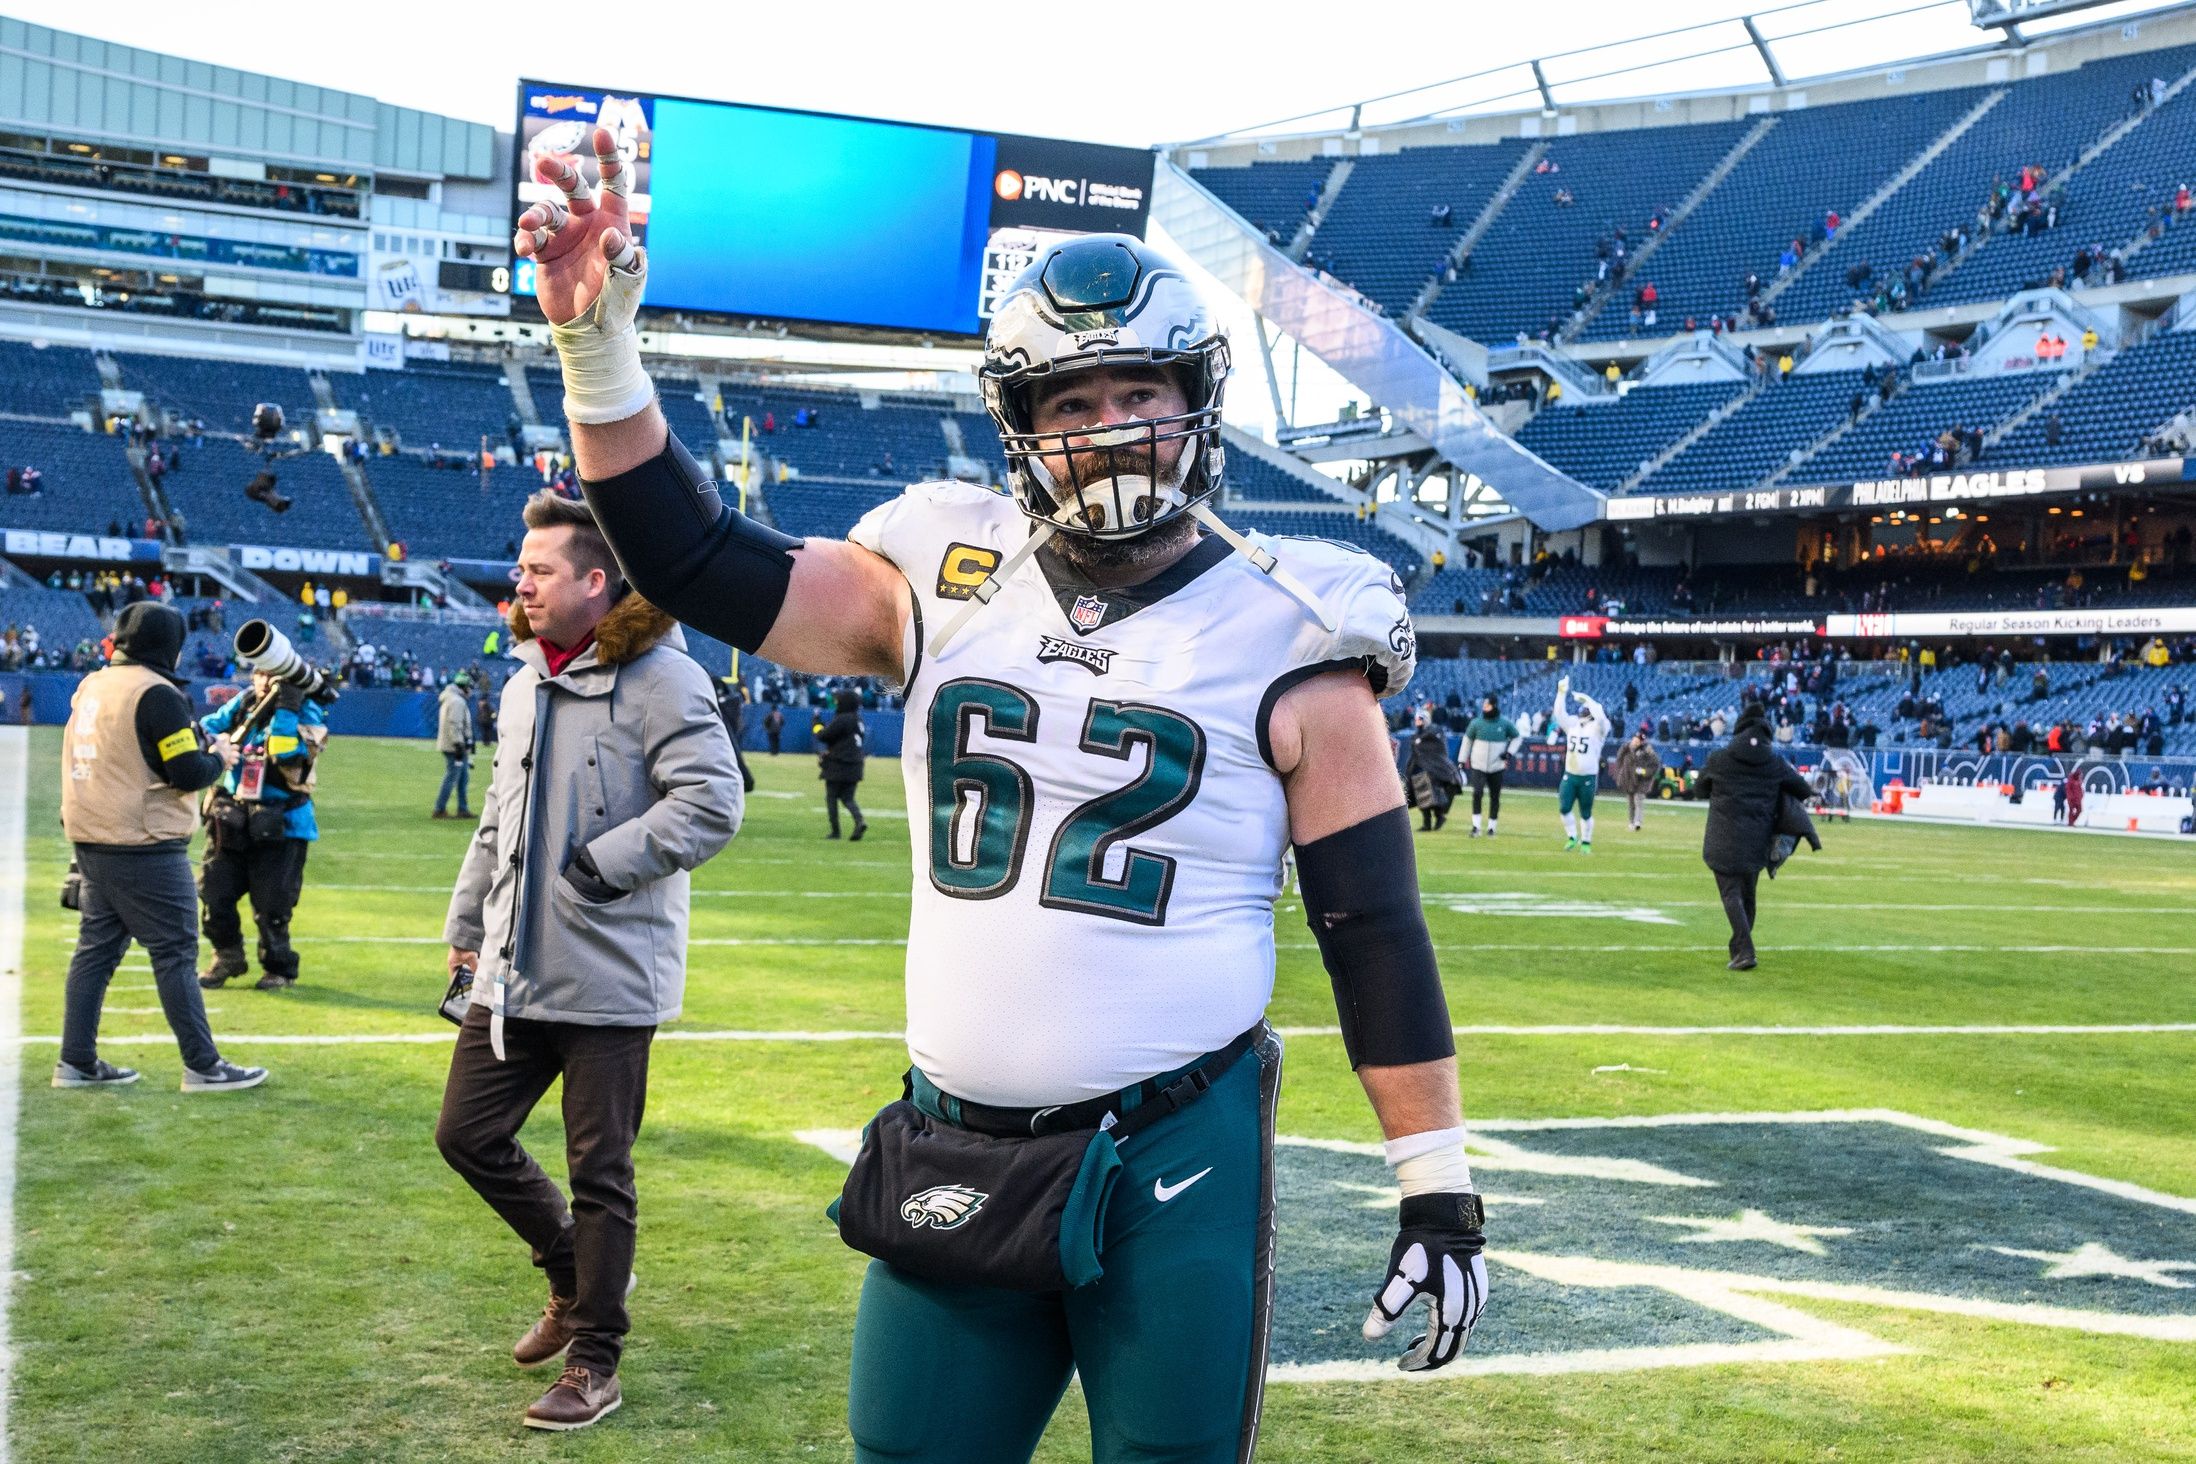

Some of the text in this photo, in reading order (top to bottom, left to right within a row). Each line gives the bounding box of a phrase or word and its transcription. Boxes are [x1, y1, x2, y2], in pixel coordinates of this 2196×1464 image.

[1023, 175, 1078, 205] PNC
[1852, 463, 2146, 506] PHILADELPHIA EAGLES VS
[5, 530, 133, 562] BEAR
[241, 548, 370, 576] DOWN
[943, 545, 1000, 585] C
[1075, 607, 1098, 624] NFL
[1949, 615, 2162, 633] Regular Season Kicking Leaders
[1036, 634, 1119, 677] EAGLES
[1569, 735, 1590, 754] 55
[926, 675, 1207, 927] 62
